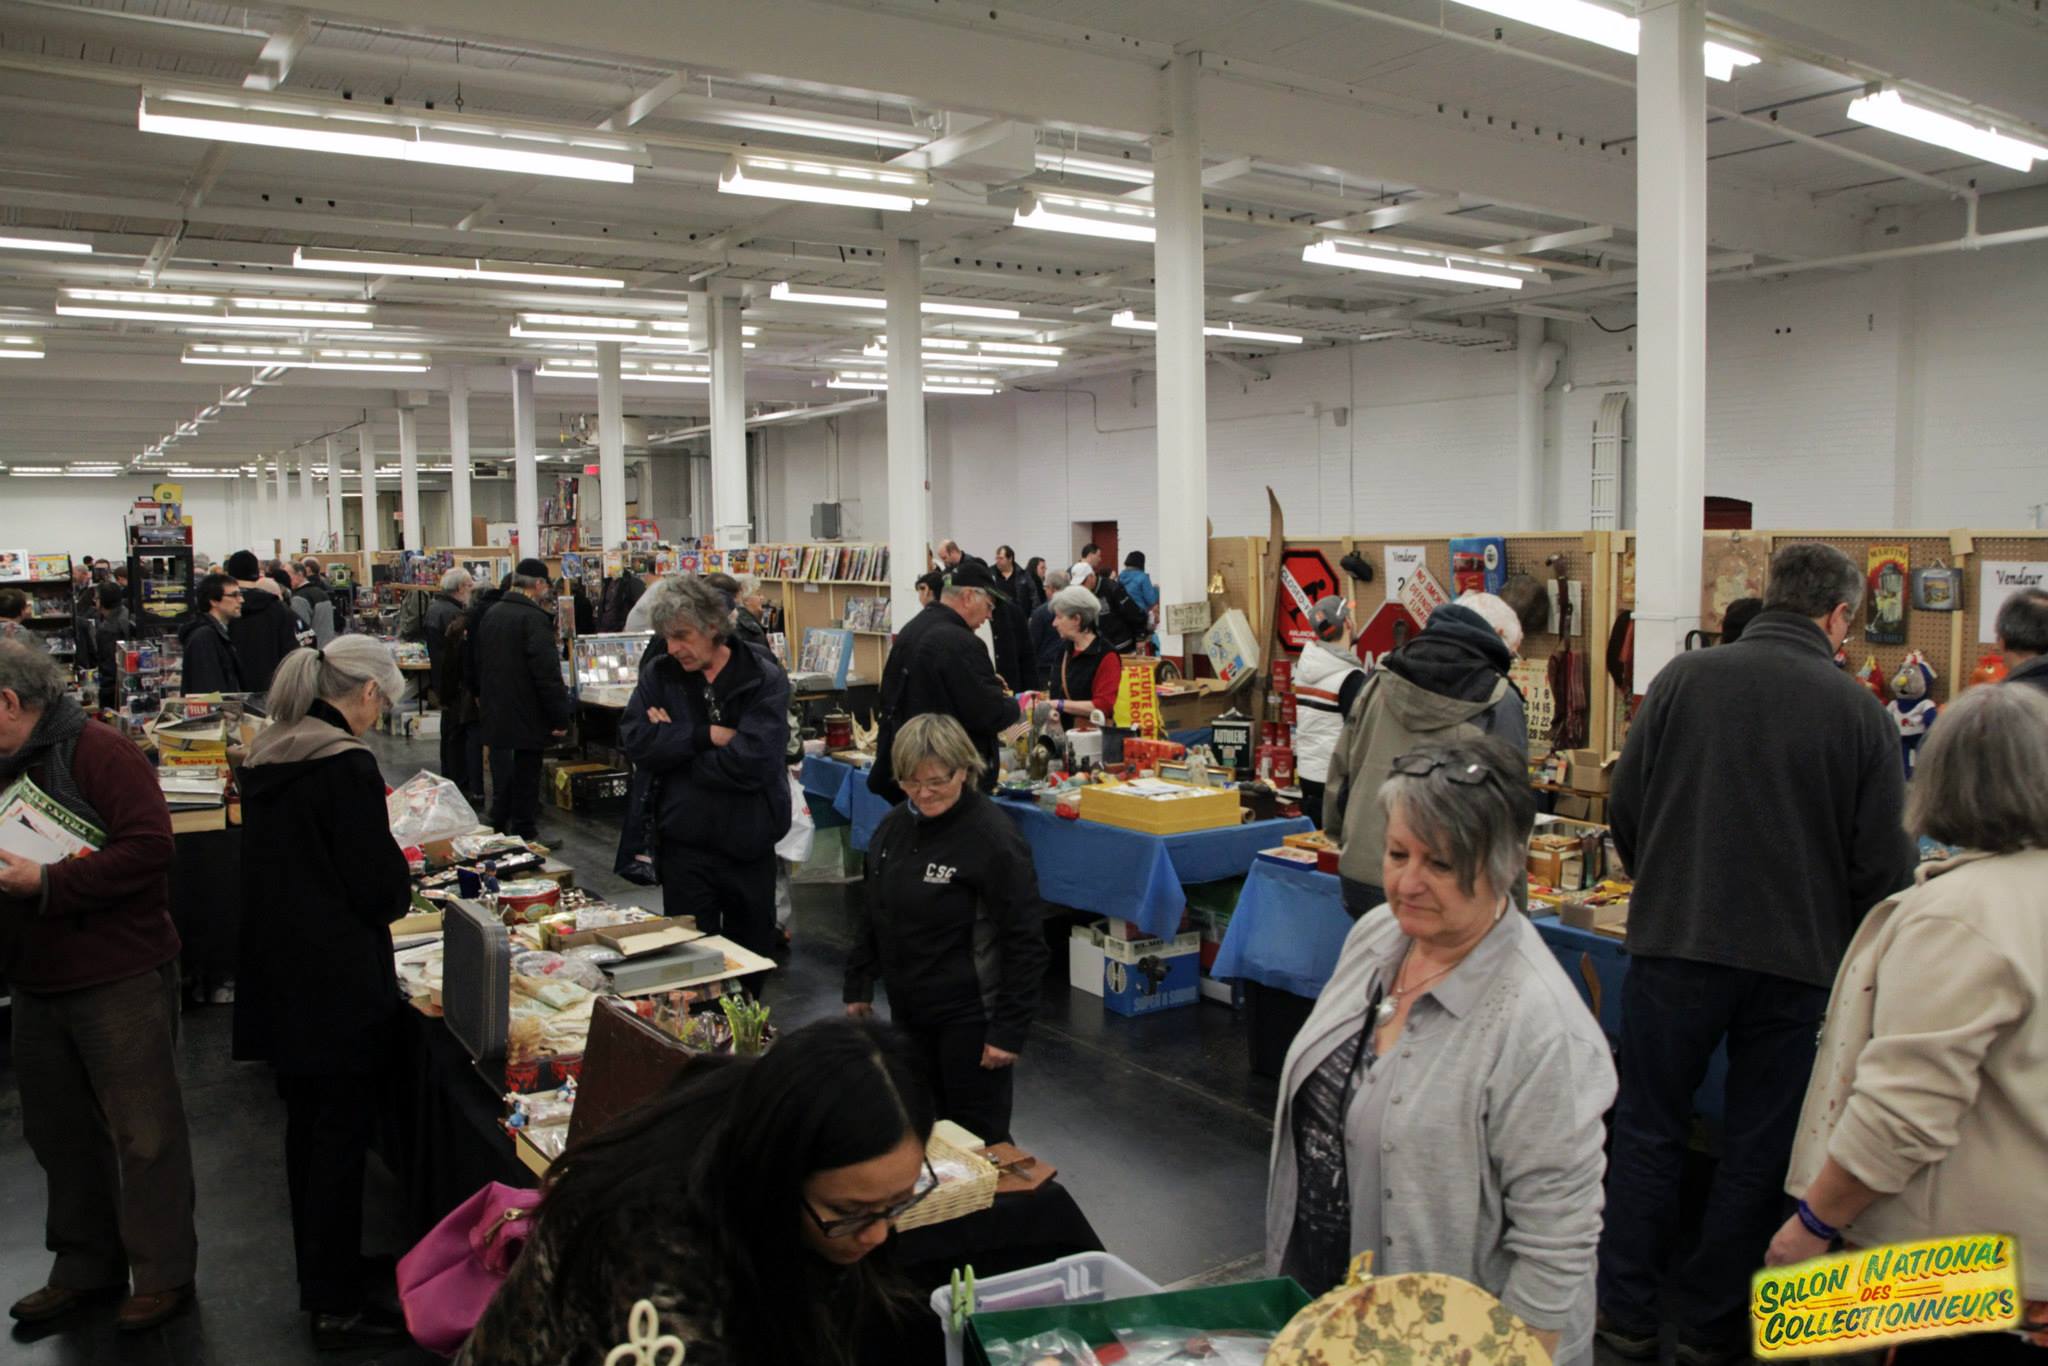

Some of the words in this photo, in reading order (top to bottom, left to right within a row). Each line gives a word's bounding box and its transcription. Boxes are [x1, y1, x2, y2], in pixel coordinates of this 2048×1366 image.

[1415, 569, 1426, 584] NO
[1996, 566, 2043, 585] Vendeur
[1129, 682, 1140, 697] LA
